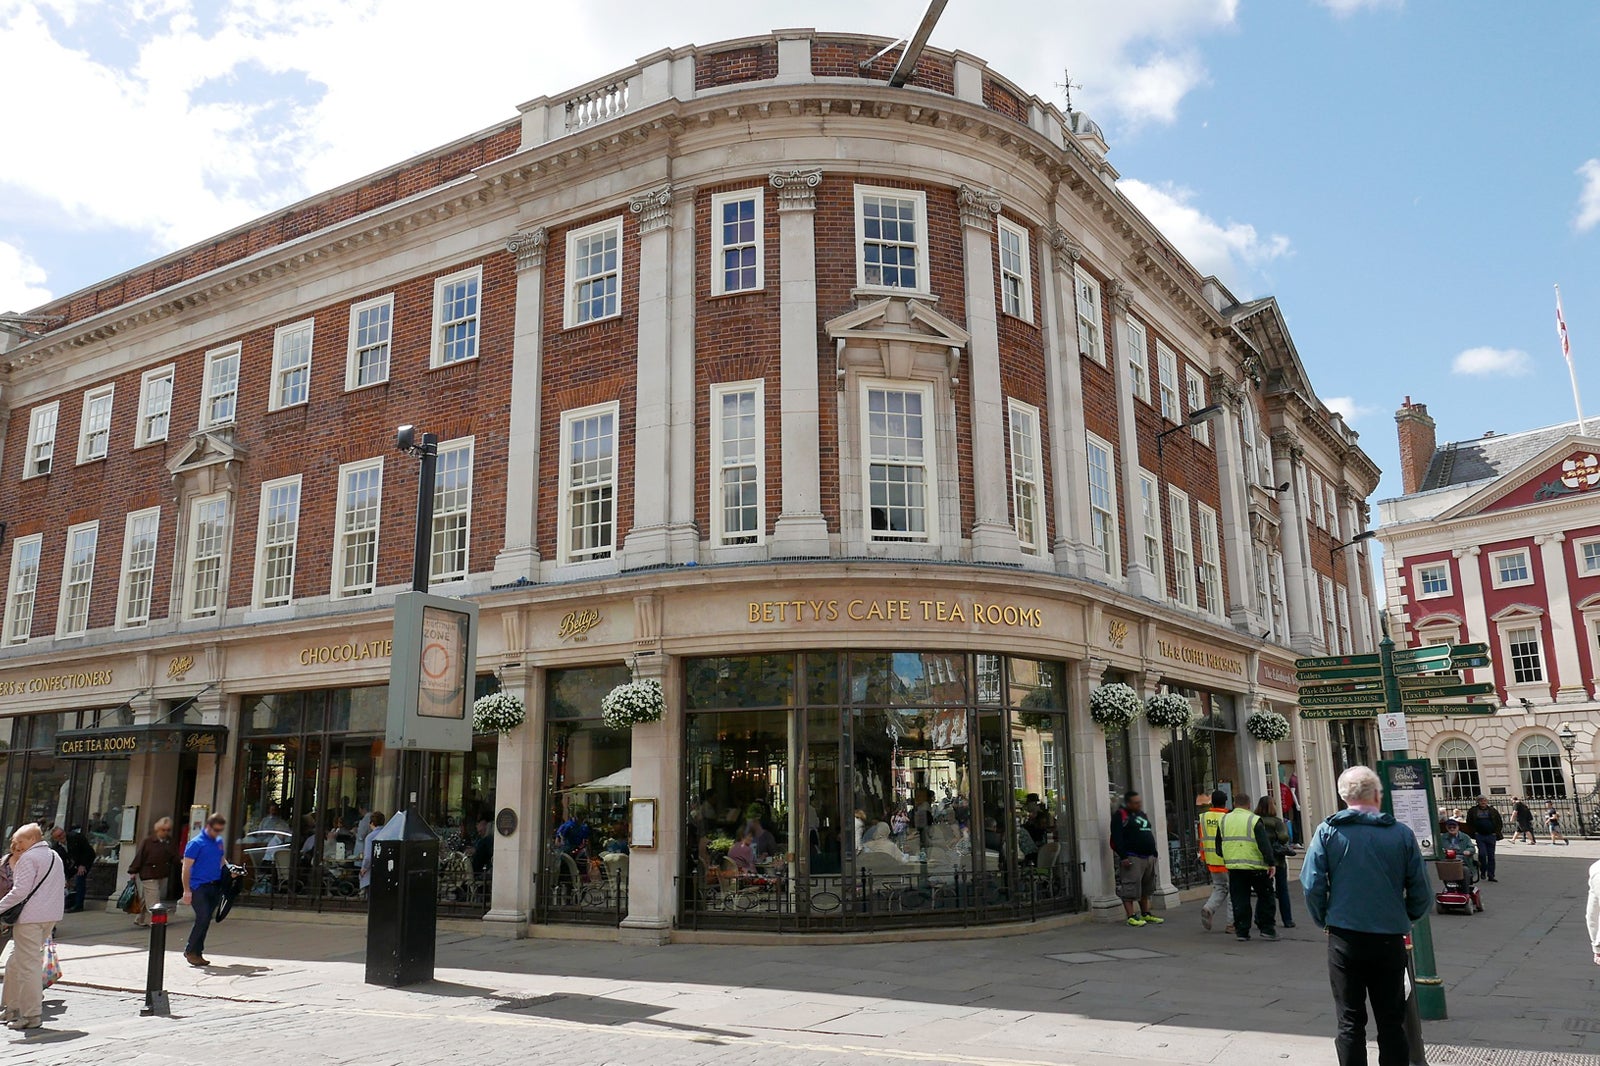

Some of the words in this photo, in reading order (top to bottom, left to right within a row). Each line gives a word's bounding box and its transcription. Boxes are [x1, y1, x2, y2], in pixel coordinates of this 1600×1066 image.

[748, 600, 838, 622] BETTYS
[847, 600, 911, 621] CAFE
[919, 600, 966, 622] TEA
[973, 603, 1042, 628] ROOMS
[558, 608, 603, 643] Bettys
[423, 628, 450, 641] ZONE
[1157, 640, 1173, 659] TEA
[1174, 647, 1181, 661] &
[1181, 646, 1205, 667] COFFEE
[1206, 653, 1242, 675] MERCHANTS
[167, 656, 195, 679] Bettys
[17, 684, 26, 694] &
[29, 669, 113, 693] CONFECTIONERS
[1302, 687, 1320, 695] Park
[1425, 689, 1445, 697] Rank
[1304, 709, 1327, 717] York's
[1329, 708, 1351, 716] Sweet
[1353, 707, 1374, 716] Story
[1405, 705, 1440, 714] Assembly
[62, 740, 83, 753] CAFE
[85, 739, 102, 751] TEA
[104, 736, 137, 750] ROOMS
